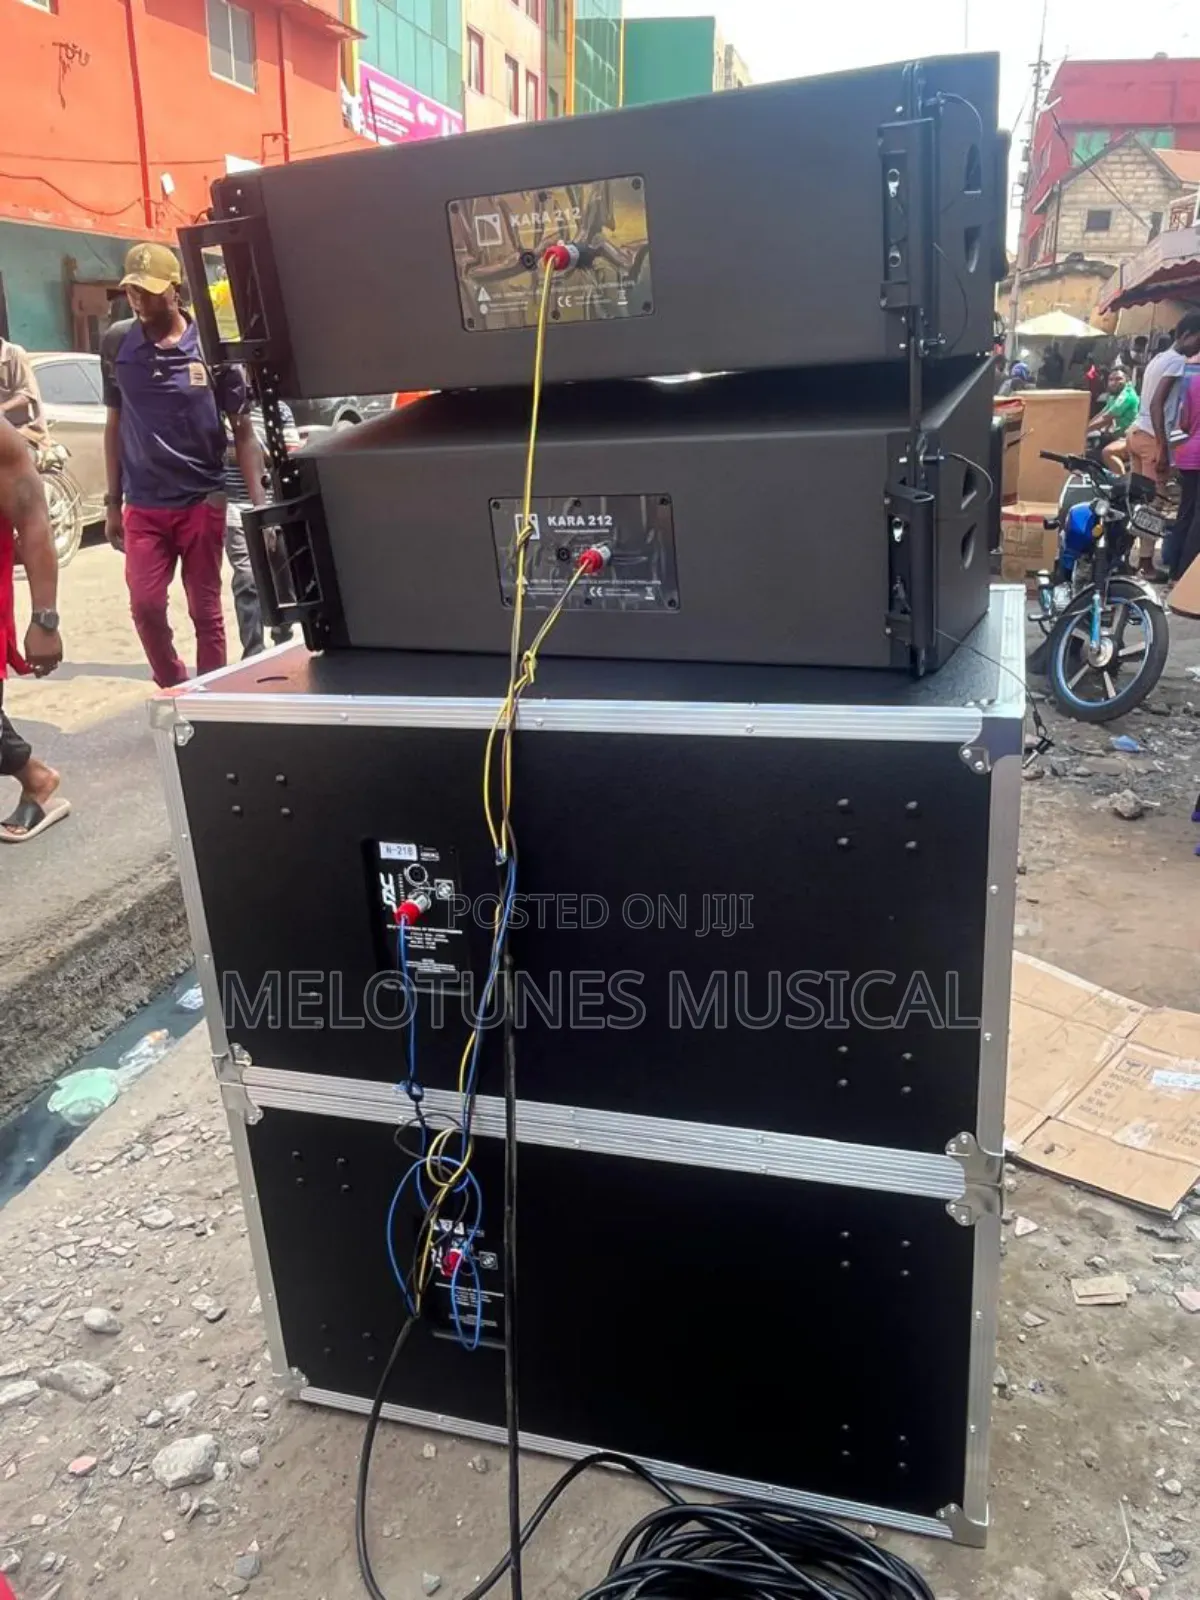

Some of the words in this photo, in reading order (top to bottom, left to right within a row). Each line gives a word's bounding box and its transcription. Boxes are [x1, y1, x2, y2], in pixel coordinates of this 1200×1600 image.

[510, 211, 552, 228] KARA
[554, 206, 582, 223] 212
[547, 515, 585, 526] KARA
[588, 515, 612, 526] 212
